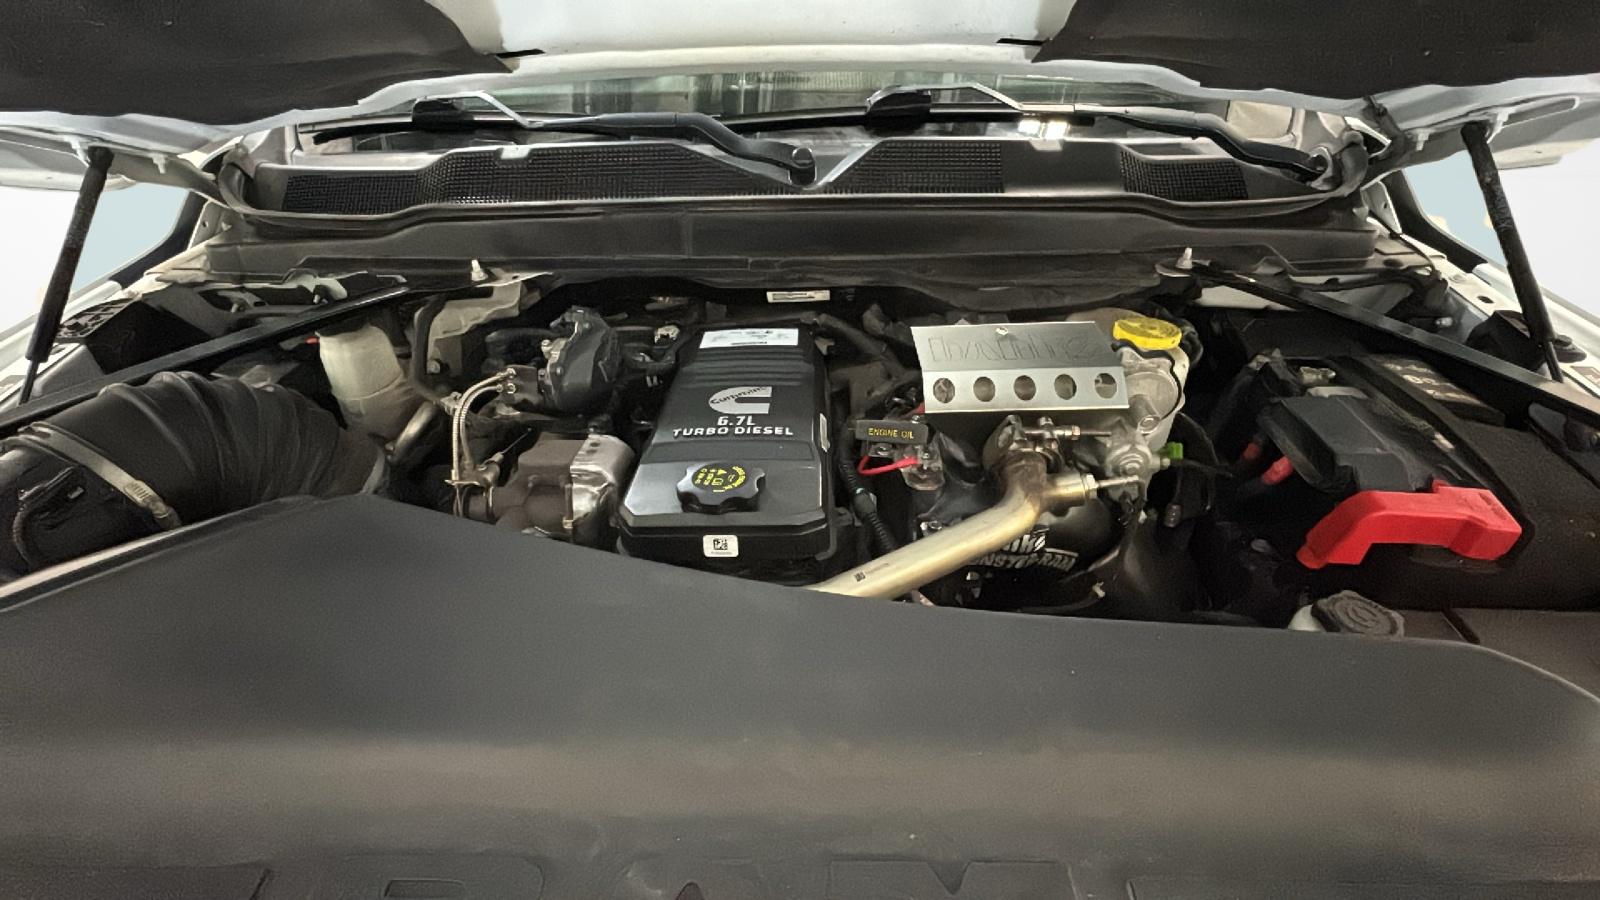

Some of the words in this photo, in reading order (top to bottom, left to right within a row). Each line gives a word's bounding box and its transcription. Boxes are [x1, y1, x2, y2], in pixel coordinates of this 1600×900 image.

[717, 415, 756, 426] 6.7L
[672, 427, 729, 437] TURBO
[734, 426, 794, 436] DIESEL
[868, 427, 898, 438] ENGINE
[901, 431, 914, 440] OIL
